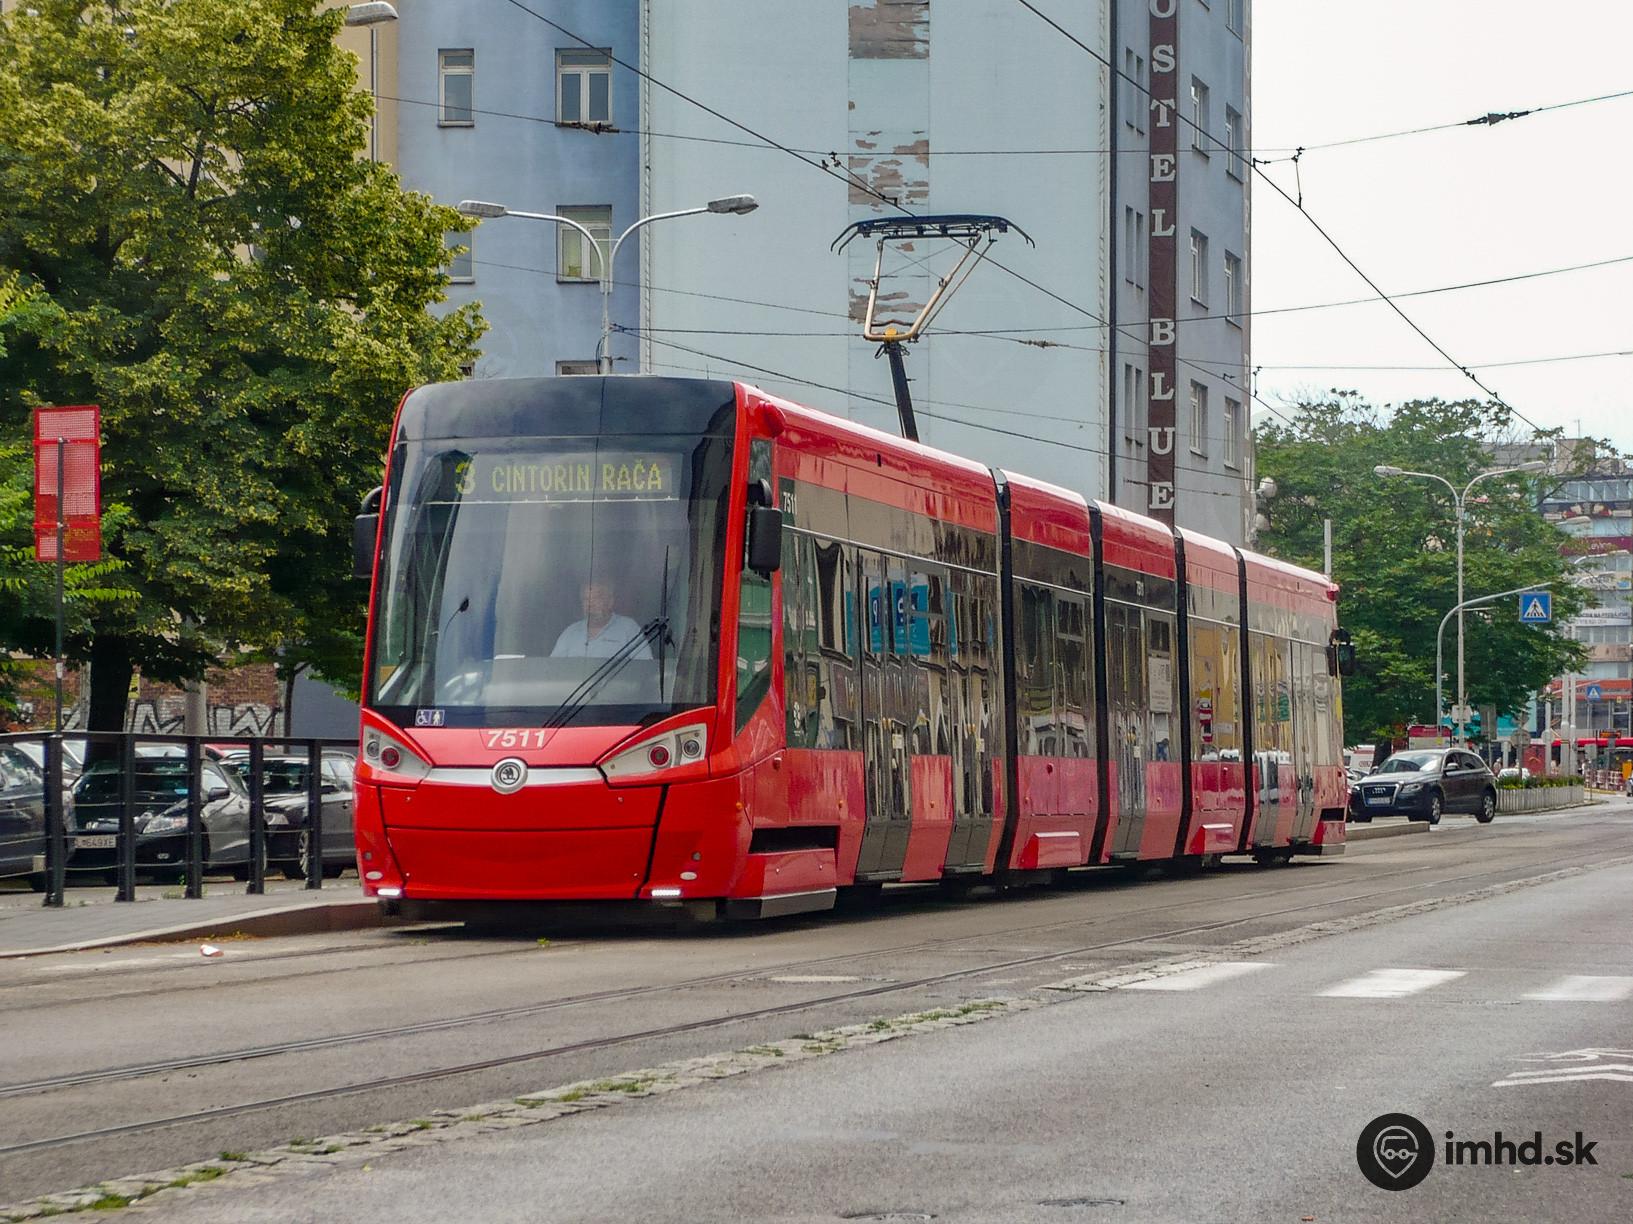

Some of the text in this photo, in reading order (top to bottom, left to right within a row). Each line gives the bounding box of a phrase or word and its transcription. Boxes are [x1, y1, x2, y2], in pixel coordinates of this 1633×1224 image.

[1149, 318, 1176, 510] BLUE
[455, 461, 477, 495] 3
[602, 459, 663, 491] RAČA
[783, 491, 798, 516] 7511
[487, 728, 546, 749] 7511
